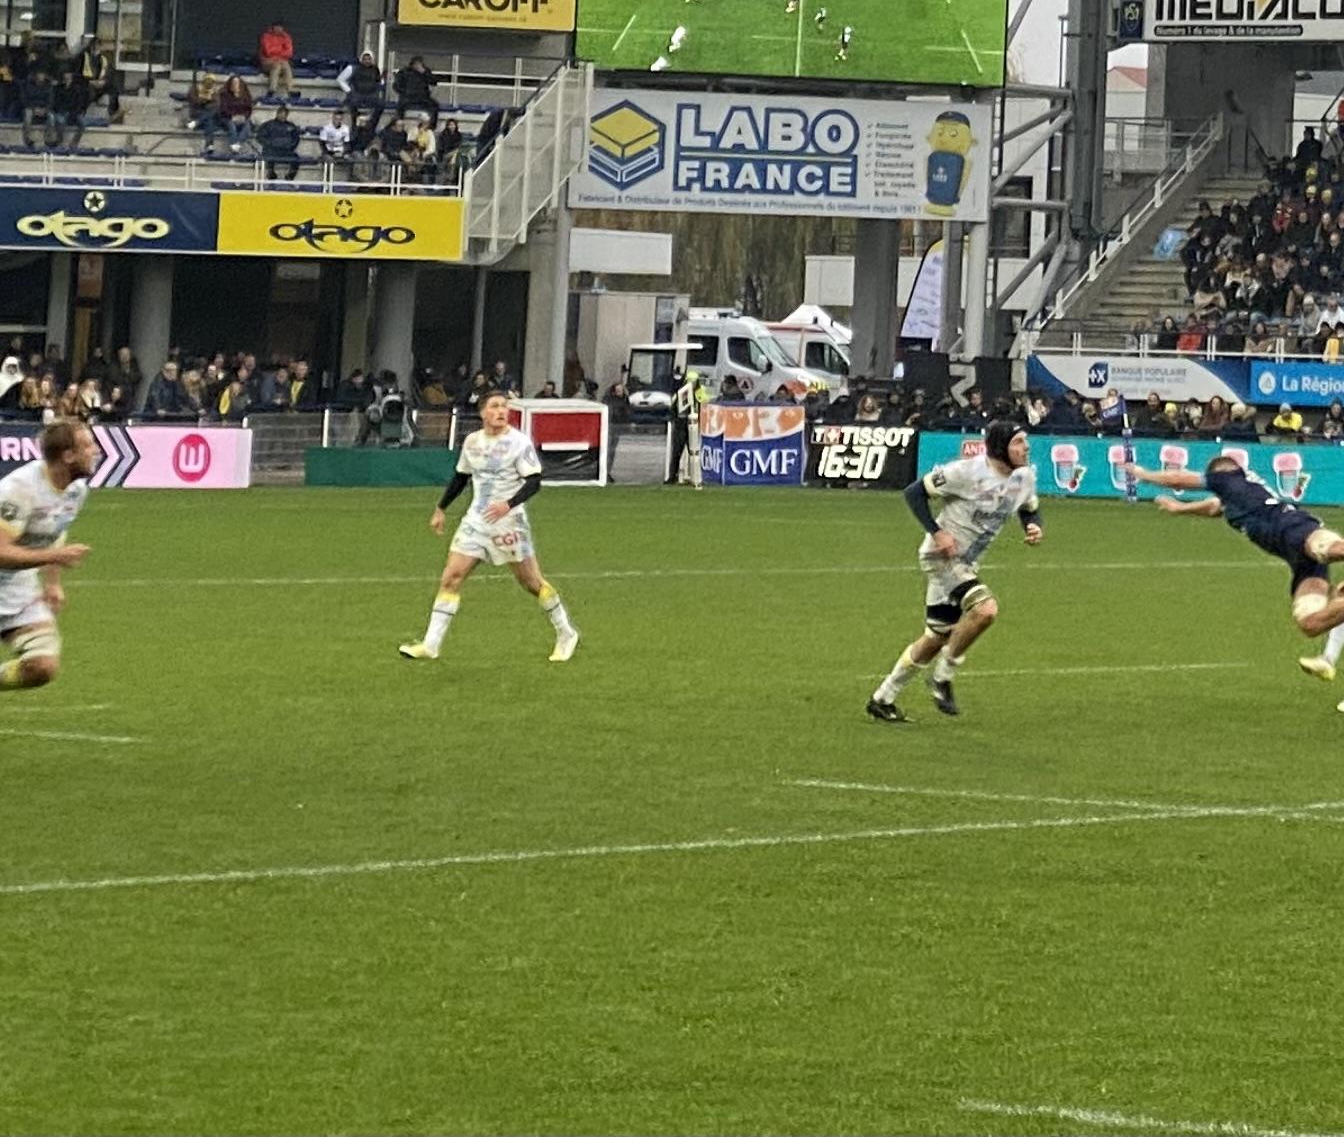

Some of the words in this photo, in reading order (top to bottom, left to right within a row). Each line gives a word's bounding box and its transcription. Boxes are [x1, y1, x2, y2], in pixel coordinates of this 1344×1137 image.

[678, 107, 857, 155] LABO
[677, 160, 854, 193] FRANCE
[1282, 375, 1298, 392] La
[841, 426, 915, 447] TISSOT
[701, 445, 723, 473] GMF
[730, 448, 798, 476] GMF
[817, 445, 889, 479] 16:30
